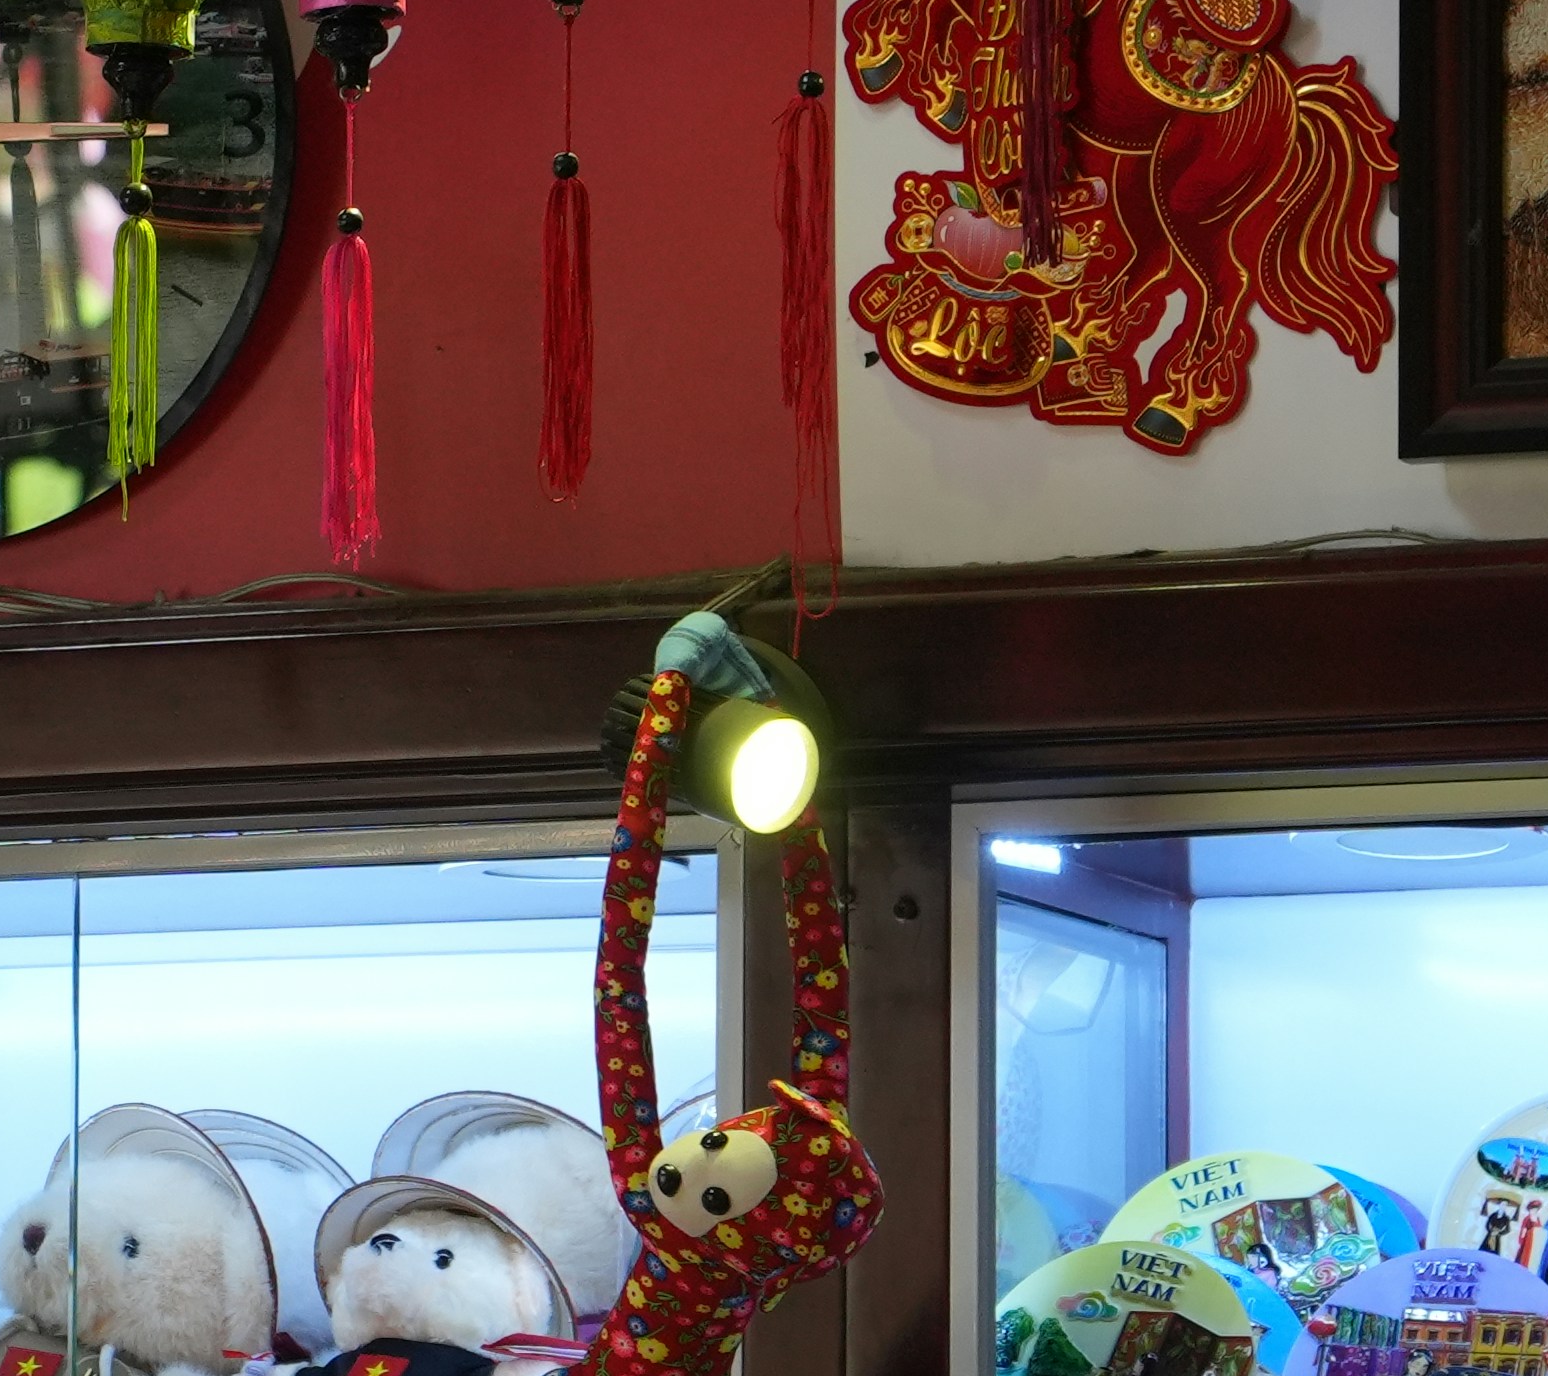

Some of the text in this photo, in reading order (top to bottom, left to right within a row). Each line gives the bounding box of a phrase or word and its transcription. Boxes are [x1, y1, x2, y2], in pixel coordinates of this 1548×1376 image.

[223, 92, 267, 158] 3
[910, 296, 1008, 376] Lộc
[1169, 1157, 1243, 1192] VIỆT
[1178, 1180, 1247, 1214] NAM
[1110, 1272, 1178, 1303] NAM
[1409, 1280, 1477, 1302] NAM
